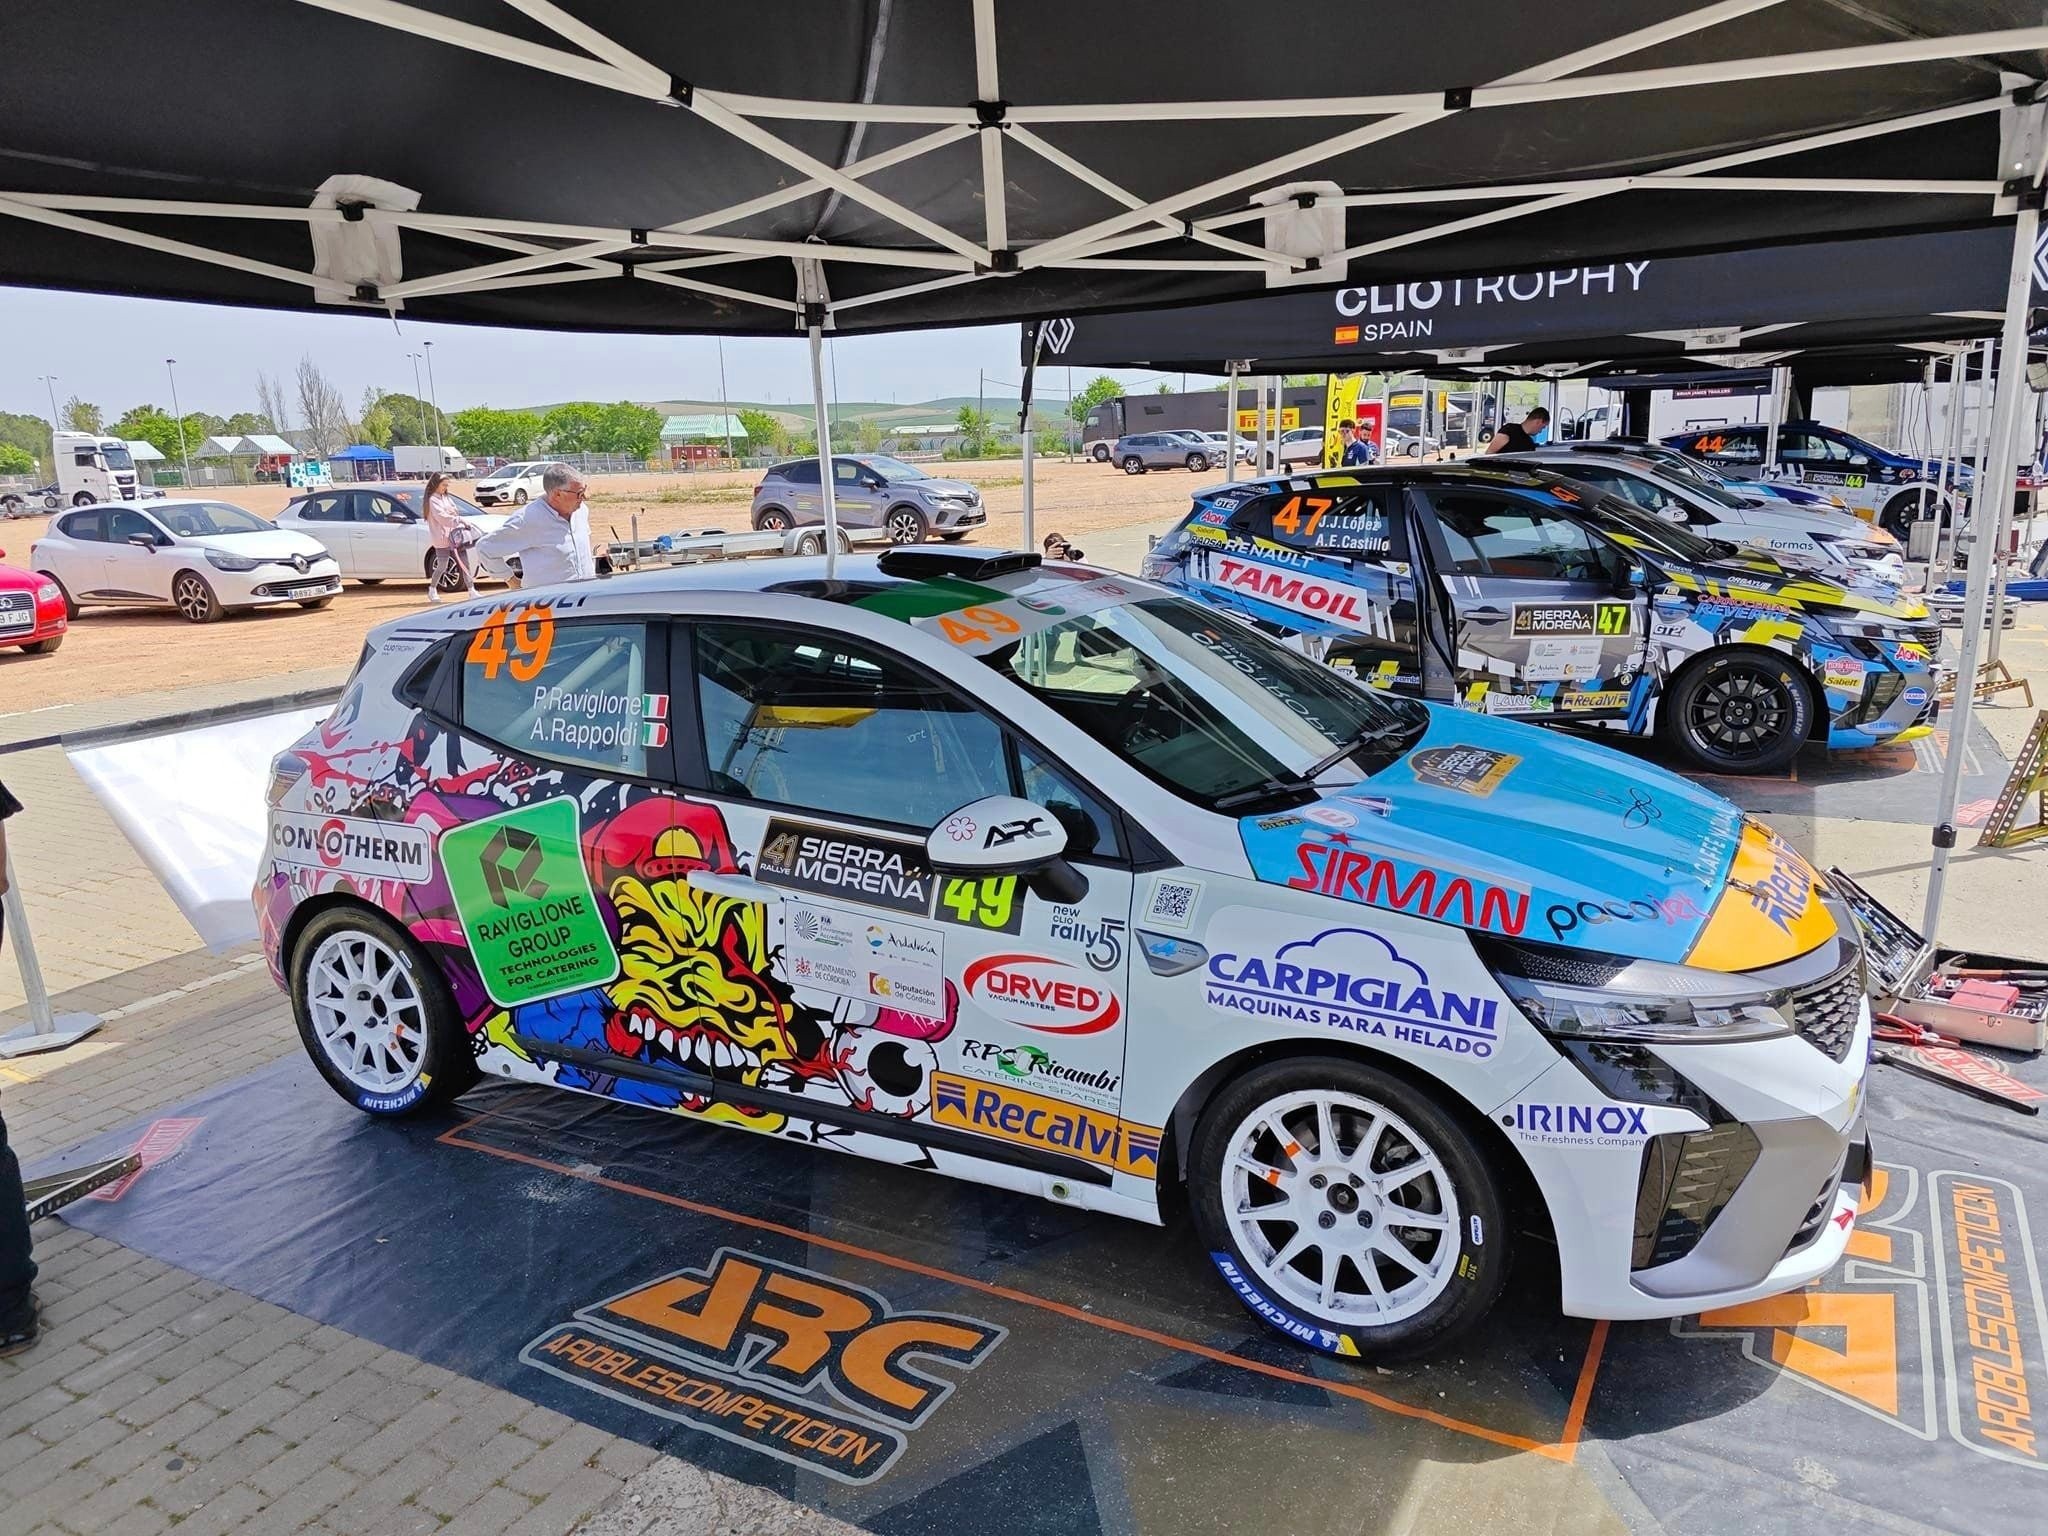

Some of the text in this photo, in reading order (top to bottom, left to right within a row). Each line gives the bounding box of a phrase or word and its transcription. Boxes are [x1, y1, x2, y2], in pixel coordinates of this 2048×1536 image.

[1364, 319, 1433, 342] SPAIN
[1695, 436, 1722, 453] 44
[1847, 475, 1864, 488] 44
[1272, 496, 1332, 535] 47
[1224, 538, 1315, 570] RENAULT
[1770, 539, 1814, 551] formas
[1218, 560, 1363, 623] TAMOIL
[937, 607, 1022, 646] 49
[1532, 620, 1592, 630] MORENA
[1533, 610, 1581, 620] SIERRA
[1598, 606, 1627, 634] 47
[465, 606, 556, 682] 49
[1827, 677, 1858, 687] Sabelt
[533, 686, 641, 719] P.Raviglione
[1575, 693, 1618, 707] Recalvi
[530, 717, 638, 749] A.Rappoldi
[759, 857, 925, 904] RALLYE MORENA
[799, 837, 904, 876] SIERRA
[943, 876, 1018, 929] 49
[1287, 843, 1531, 936] SIRMAN
[478, 896, 585, 943] RAVIGLIONE
[1053, 905, 1080, 918] new
[1053, 915, 1074, 925] CLIO
[508, 926, 571, 958] GROUP
[888, 932, 938, 956] Andalucía
[499, 943, 598, 976] TECHNOLOGIES
[507, 974, 534, 987] FOR
[536, 957, 599, 979] CATERING
[814, 962, 857, 978] AYUNTAMIENTO
[814, 971, 851, 986] DE CÓRDOBA
[894, 981, 935, 998] Diputación
[986, 970, 1100, 1012] ORVED
[1208, 953, 1498, 1030] CARPIGIANI
[905, 992, 936, 1006] Córdoba
[988, 993, 1056, 1012] VACUUM MASTERS
[1208, 990, 1493, 1058] MAQUINAS PARA HELADO
[962, 1065, 1045, 1090] CATERING
[1048, 1085, 1120, 1111] SPARES
[1028, 1053, 1121, 1092] Ricambi
[363, 1088, 416, 1110] MICHELIN
[972, 1088, 1123, 1162] Recalvi
[1517, 1103, 1648, 1135] IRINOX
[1518, 1132, 1539, 1142] The
[1541, 1135, 1595, 1146] Freshness
[1219, 1259, 1316, 1343] MICHELIN
[538, 1332, 882, 1466] AROBLESCOMPETICION
